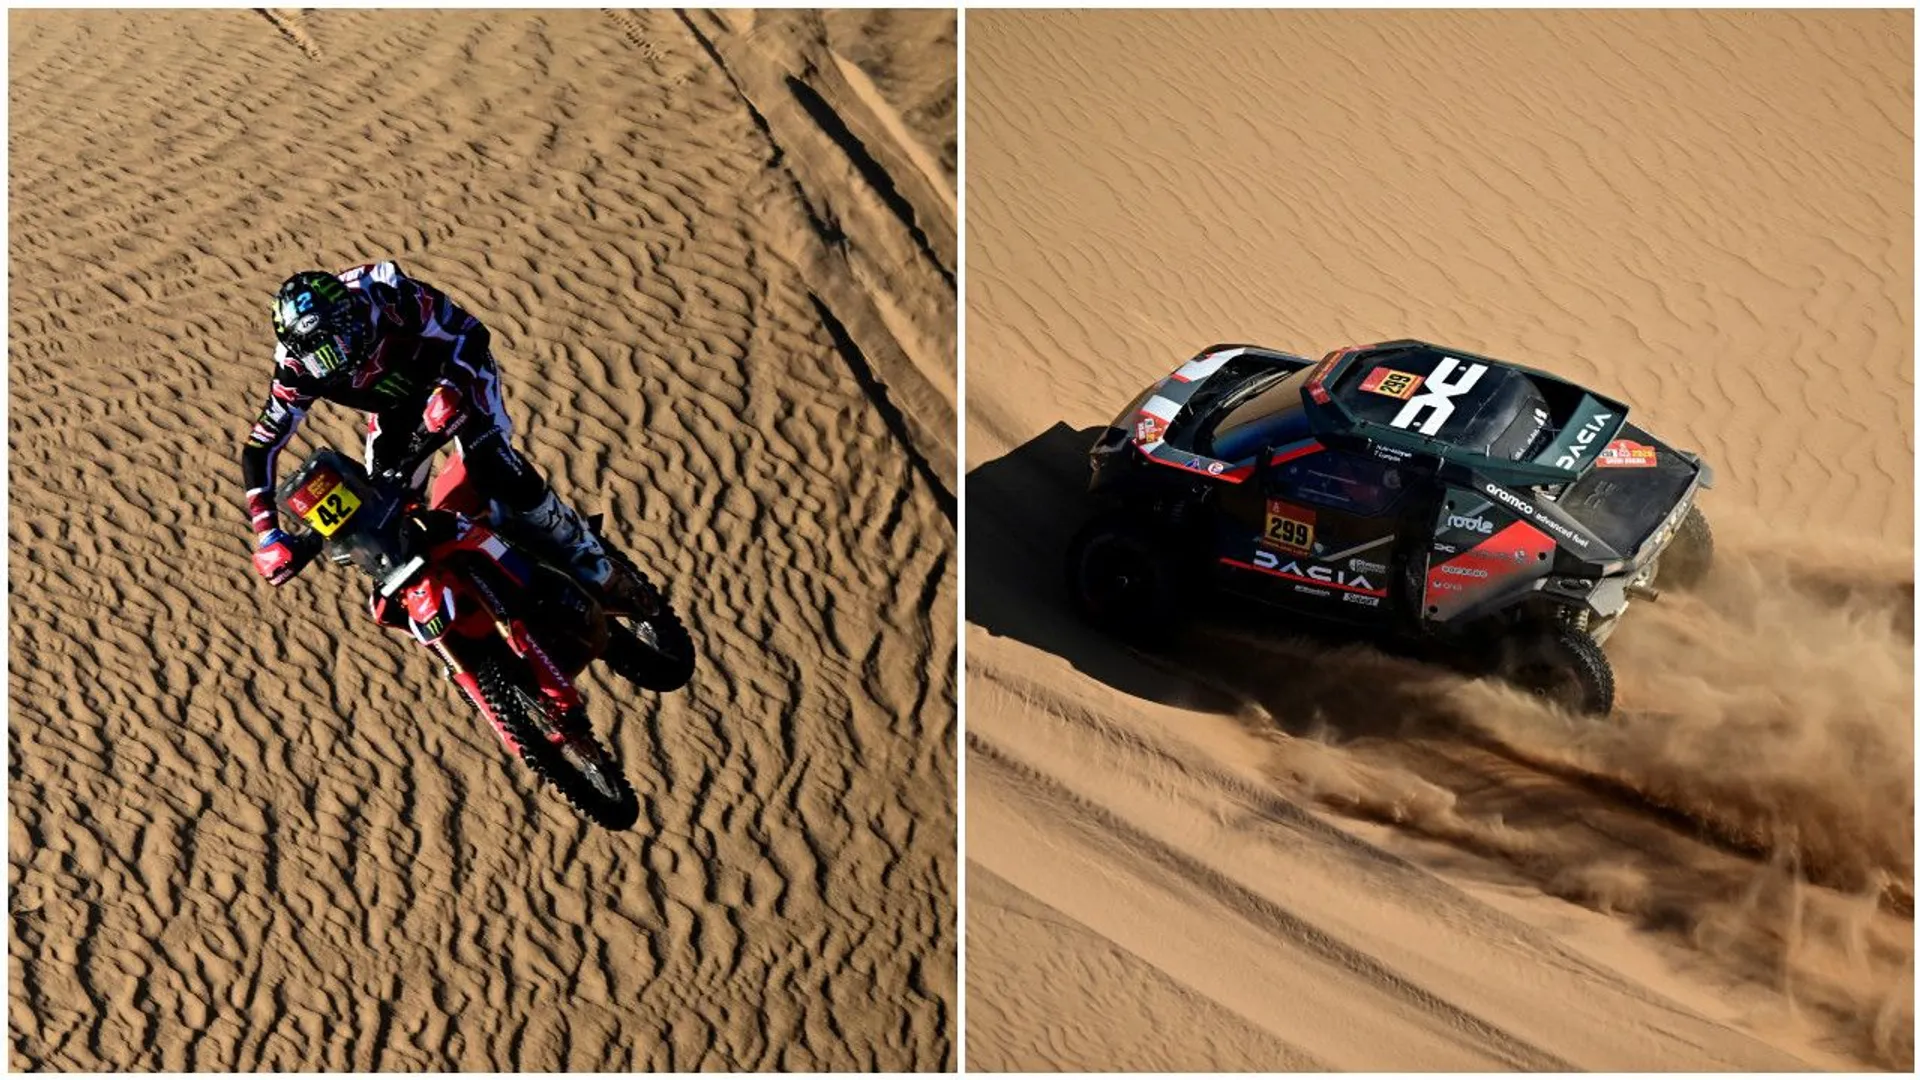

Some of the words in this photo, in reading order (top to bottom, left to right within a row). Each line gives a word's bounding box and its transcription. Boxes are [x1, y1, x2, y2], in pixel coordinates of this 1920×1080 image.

[1380, 373, 1412, 397] 299
[1555, 412, 1612, 470] DACIA
[317, 493, 353, 527] 42
[1486, 483, 1533, 516] aramco
[1535, 511, 1573, 540] advanced
[1572, 531, 1589, 547] fuel
[1270, 517, 1308, 546] 299
[1252, 549, 1374, 590] DACIA
